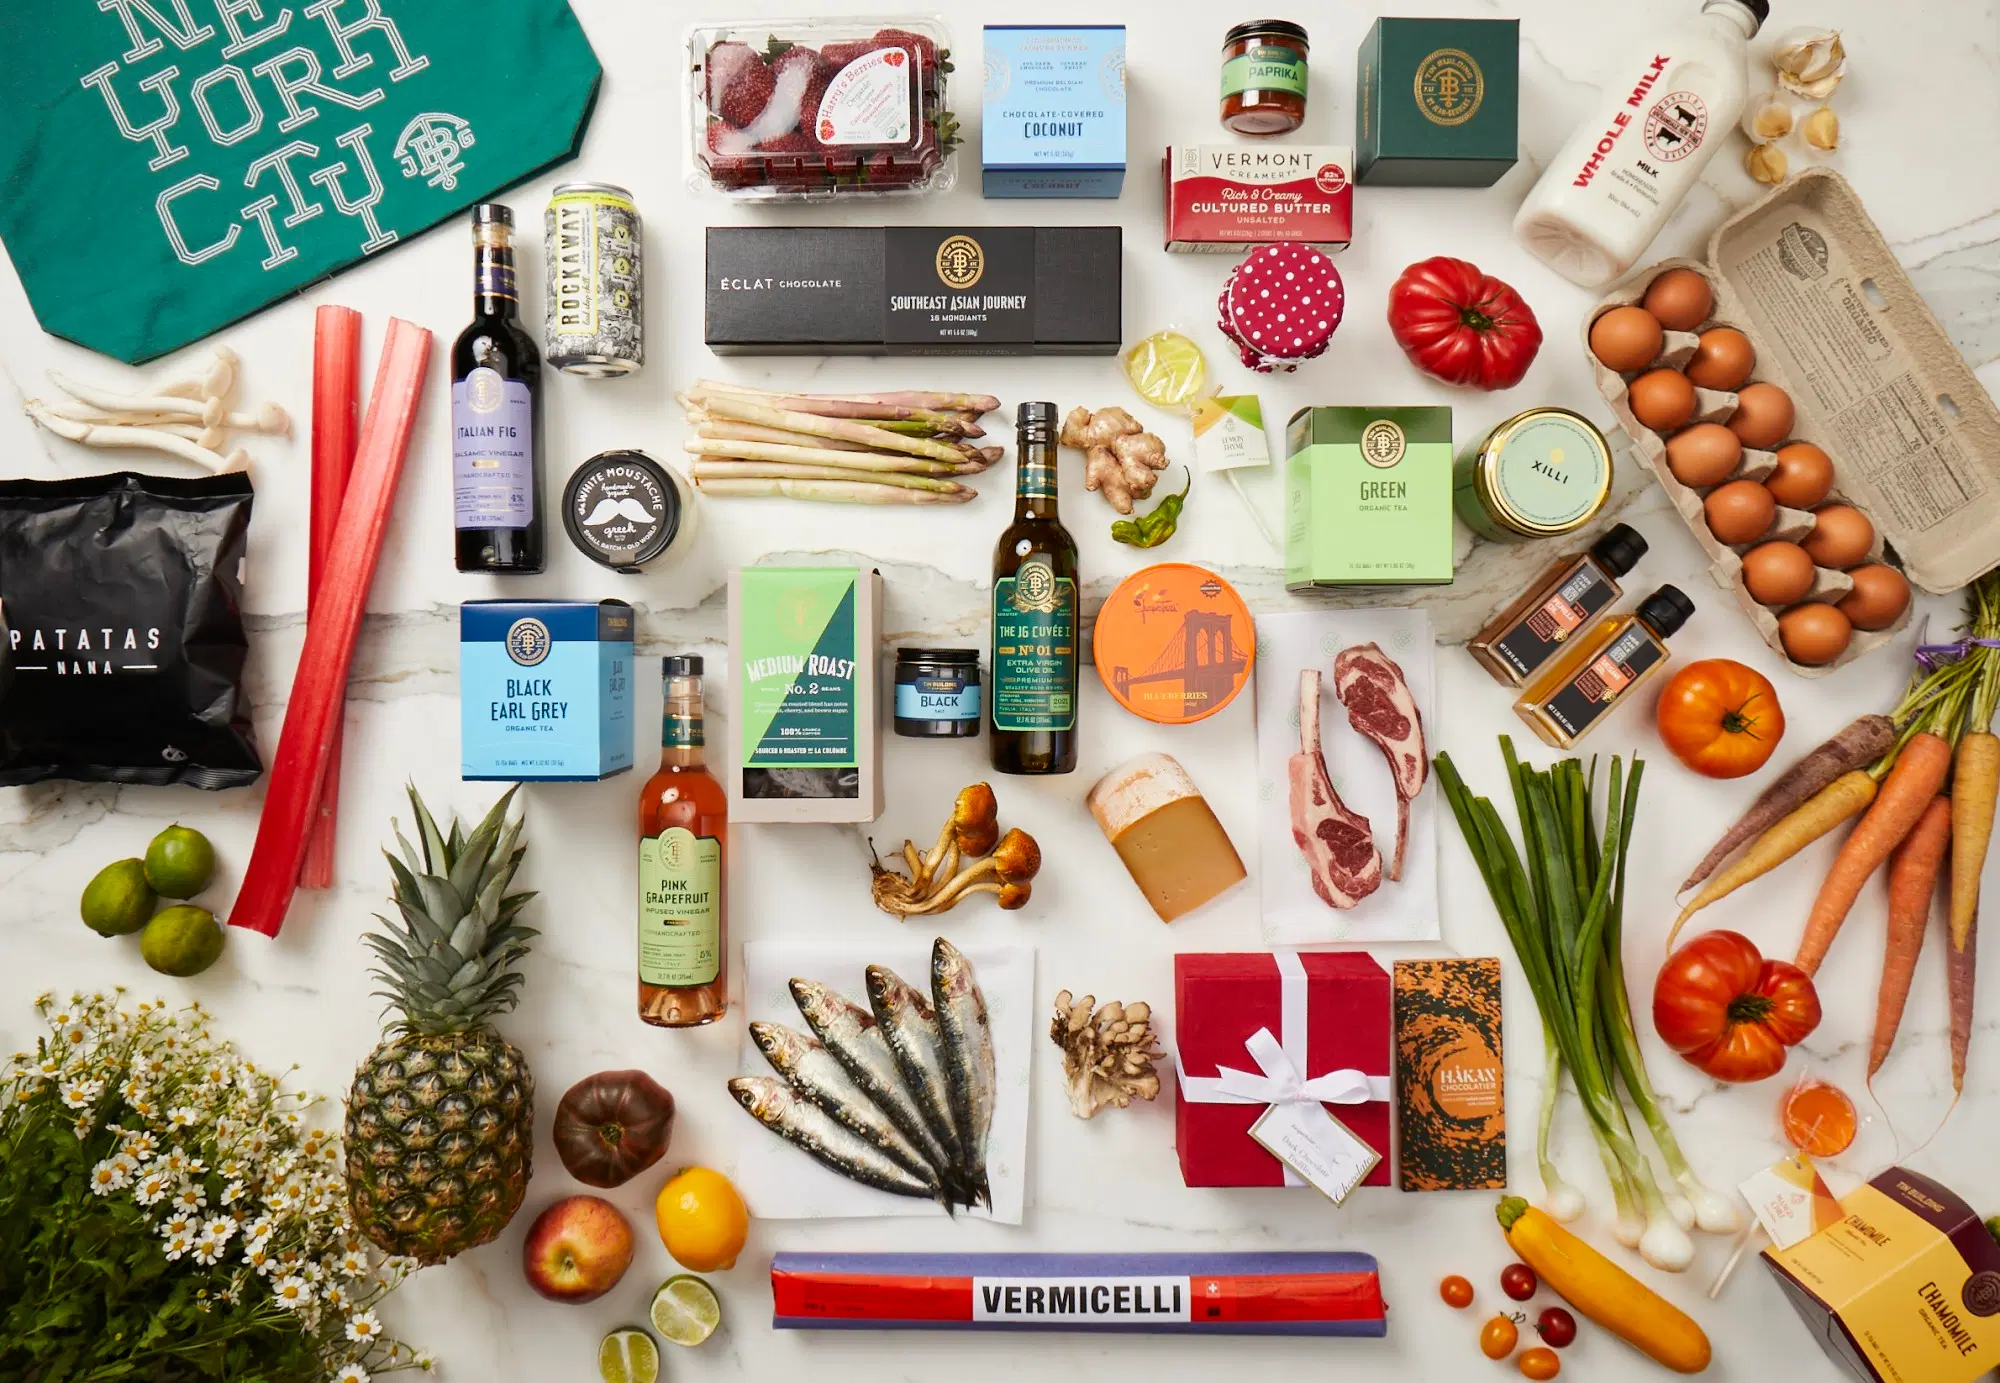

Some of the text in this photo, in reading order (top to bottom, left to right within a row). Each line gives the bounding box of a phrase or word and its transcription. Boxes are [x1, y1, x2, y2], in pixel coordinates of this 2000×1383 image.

[1249, 66, 1298, 80] PAPRIKA
[80, 0, 431, 171] YORK
[822, 82, 848, 119] Harry's
[845, 57, 883, 82] Berries
[1002, 110, 1104, 118] CHOCOLATE-COVERED
[1573, 54, 1672, 188] WHOLE MILK
[1024, 122, 1084, 138] COCONUT
[1212, 153, 1313, 170] VERMONT
[1636, 160, 1660, 179] MILK
[156, 123, 399, 271] CITY
[1221, 188, 1303, 204] Rich & Creamy
[1191, 202, 1332, 214] CULTURED BUTTER
[1237, 216, 1286, 224] UNSALTED
[561, 208, 582, 326] ROCKAWAY
[720, 277, 842, 291] ÉCLAT CHOCOLATE
[890, 295, 1027, 312] SOUTHEAST ASIAN JOURNEY
[941, 314, 988, 322] MONDIANTS
[1842, 296, 1878, 346] ORGANIC
[457, 425, 517, 440] ITALIAN FIG
[454, 450, 524, 458] BALSAMIC VINEGAR
[1531, 460, 1569, 485] XILLI
[577, 466, 663, 511] WHITE MOUSTACHE
[601, 482, 636, 492] handmade
[606, 490, 630, 498] yogurt
[1360, 480, 1407, 501] GREEN
[510, 494, 525, 503] 4%
[1358, 504, 1408, 512] ORGANIC TEA
[583, 525, 658, 551] SMALL BATCH OLD WORLD
[603, 521, 637, 539] greek
[9, 627, 161, 651] PATATAS
[999, 625, 1016, 639] THE
[1017, 625, 1029, 639] JG
[1032, 623, 1063, 639] CUVÉE
[1036, 645, 1052, 657] 01
[57, 660, 113, 675] NANA
[745, 653, 855, 684] MEDIUM ROAST
[1006, 659, 1063, 667] EXTRA VIRGIN
[1015, 666, 1041, 674] OLIVE
[506, 679, 552, 699] BLACK
[783, 683, 807, 695] No.
[808, 682, 819, 695] 2
[1143, 691, 1209, 701] BLUEBERRIES
[920, 695, 959, 708] BLACK
[491, 702, 569, 722] EARL GREY
[780, 727, 802, 736] 100%
[661, 879, 688, 891] PINK
[646, 891, 710, 905] GRAPEFRUIT
[645, 907, 711, 916] INFUSED VINEGAR
[1440, 1064, 1496, 1084] HÅKAN
[1440, 1082, 1497, 1092] CHOCOLATIER
[1281, 1135, 1298, 1153] Dark
[1298, 1149, 1331, 1178] Chocolate
[1288, 1154, 1313, 1177] Truffles
[1334, 1156, 1376, 1202] Chocolates
[1895, 1180, 1946, 1213] TIN BUILDING
[1843, 1214, 1892, 1247] CHAMOMILE
[981, 1284, 1181, 1314] VERMICELLI
[1917, 1281, 1978, 1357] CHAMOMILE
[1918, 1308, 1948, 1350] ORGANIC TEA
